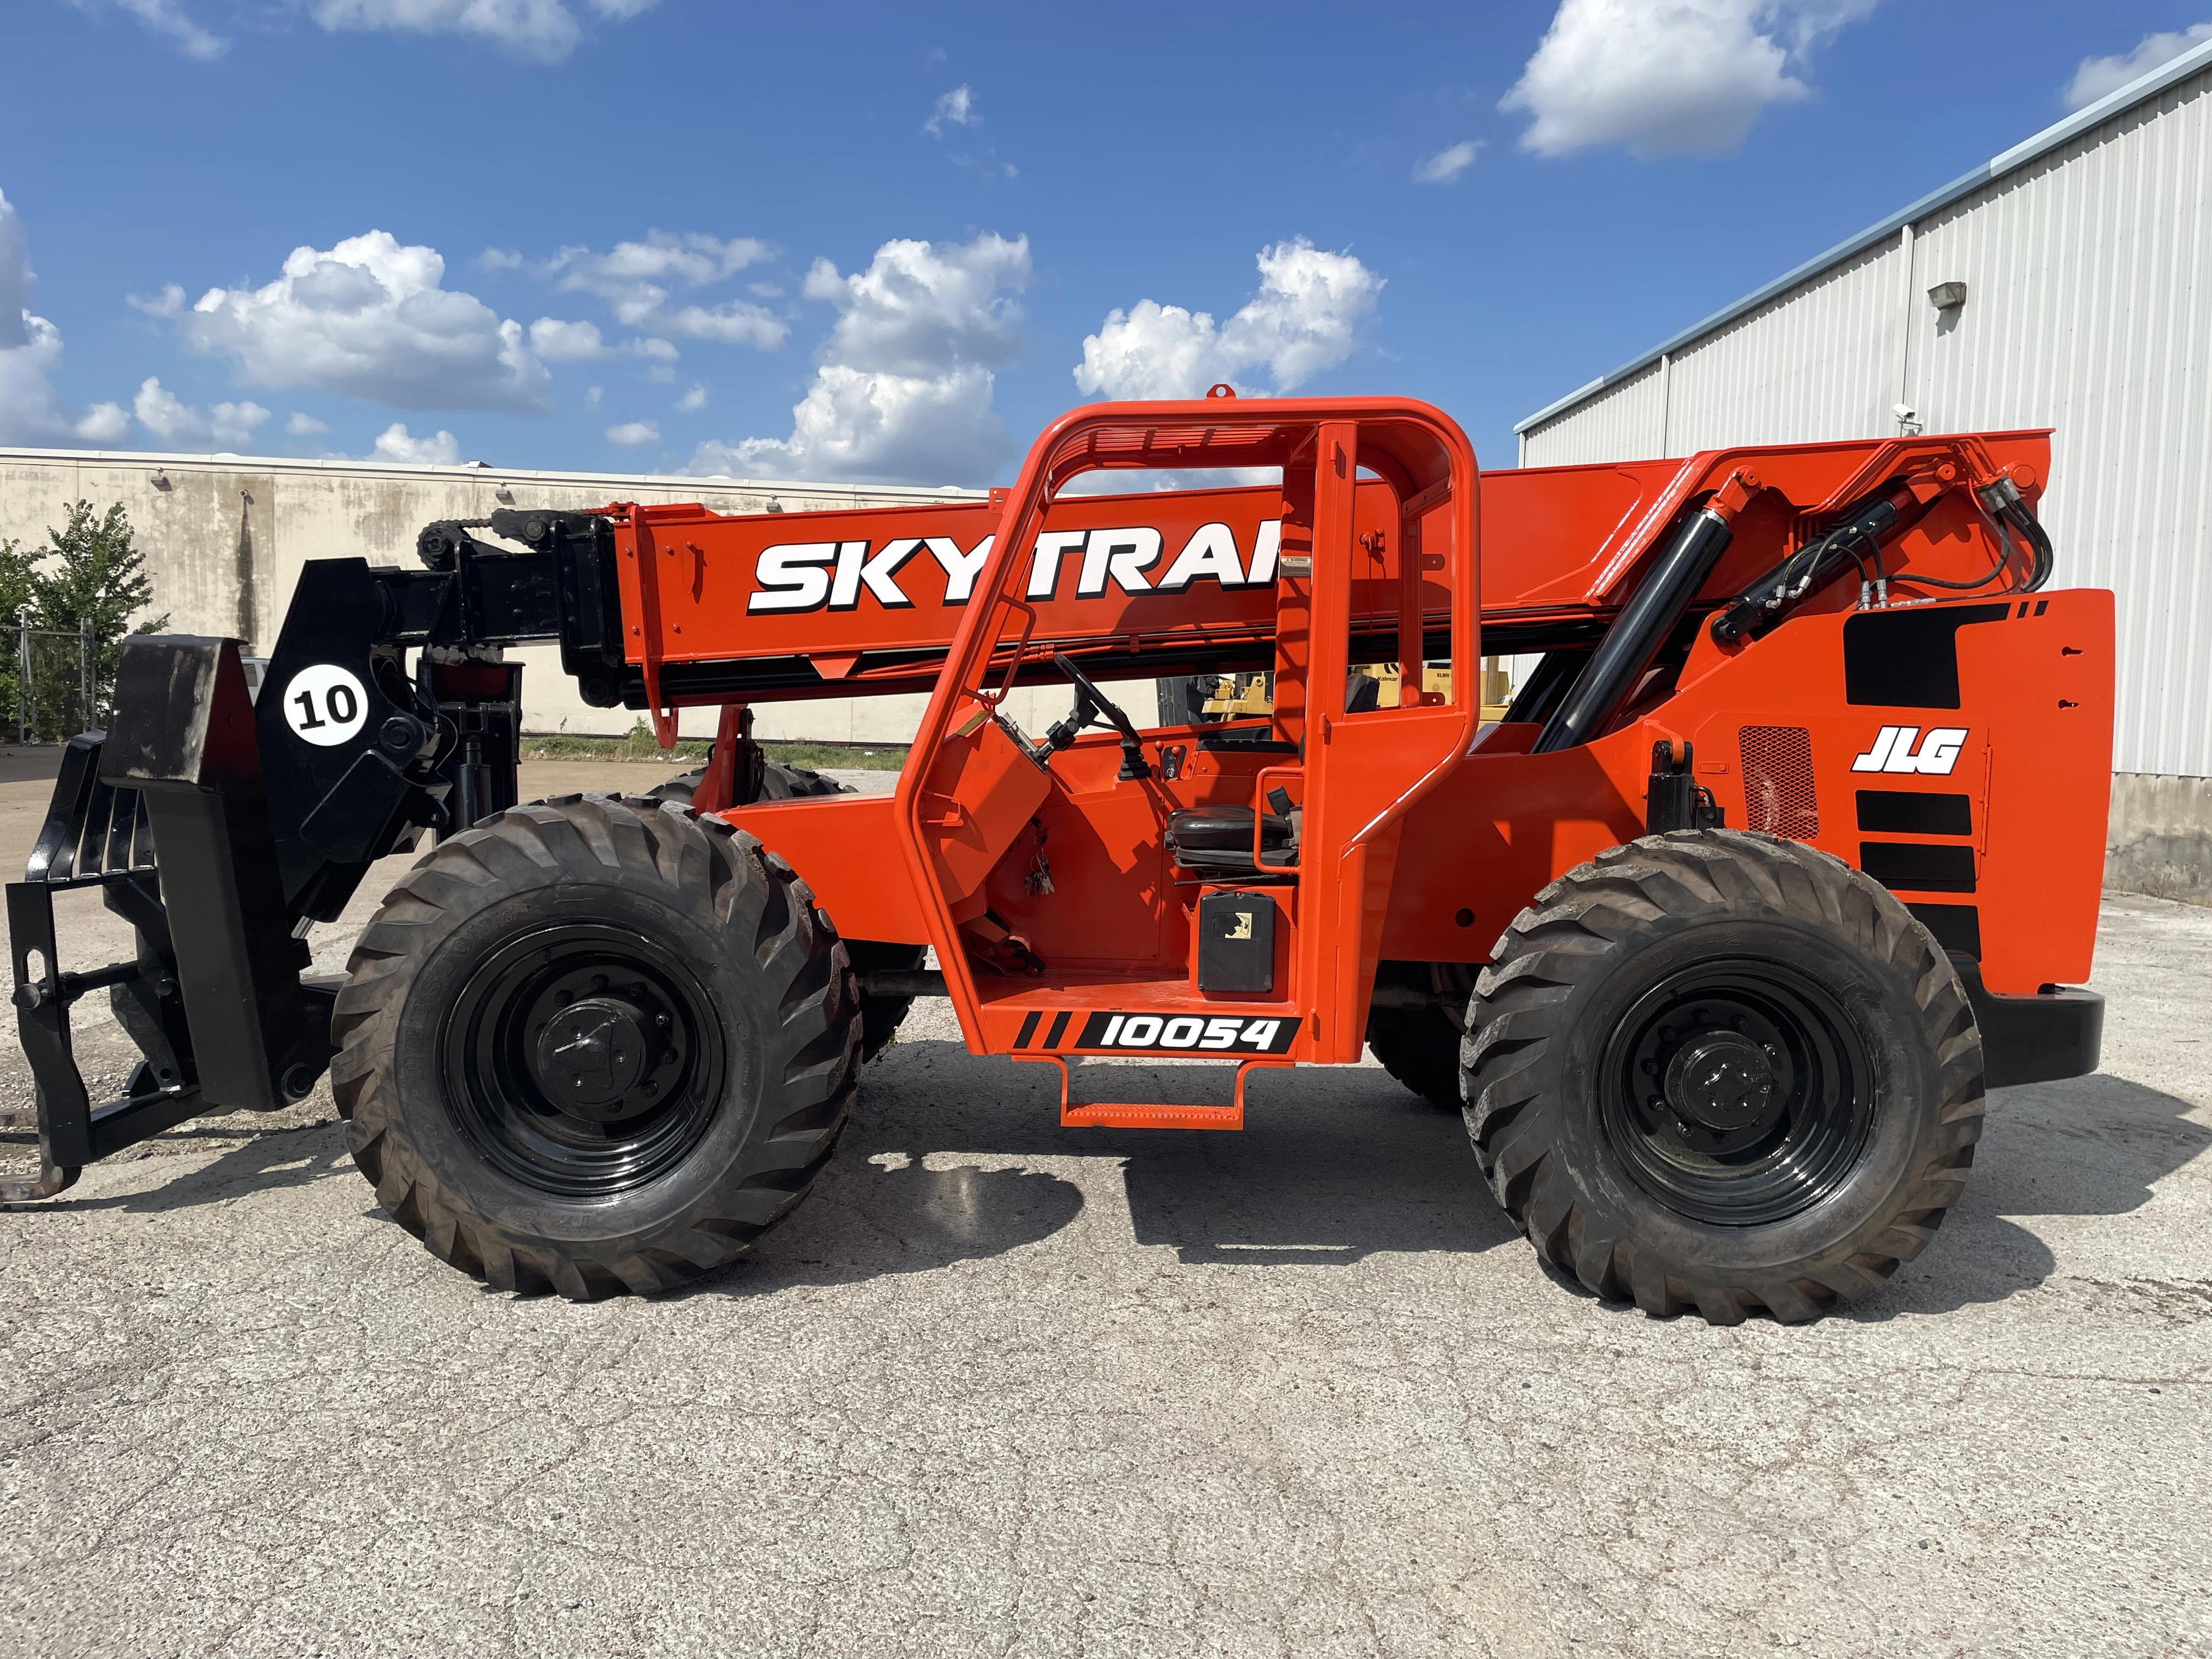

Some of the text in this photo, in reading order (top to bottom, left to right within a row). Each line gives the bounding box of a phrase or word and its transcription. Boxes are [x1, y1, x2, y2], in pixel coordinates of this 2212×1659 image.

[294, 684, 358, 731] 10
[1849, 725, 1971, 776] JLG
[403, 906, 518, 1081] DEESTONE
[1100, 1015, 1281, 1050] 10054
